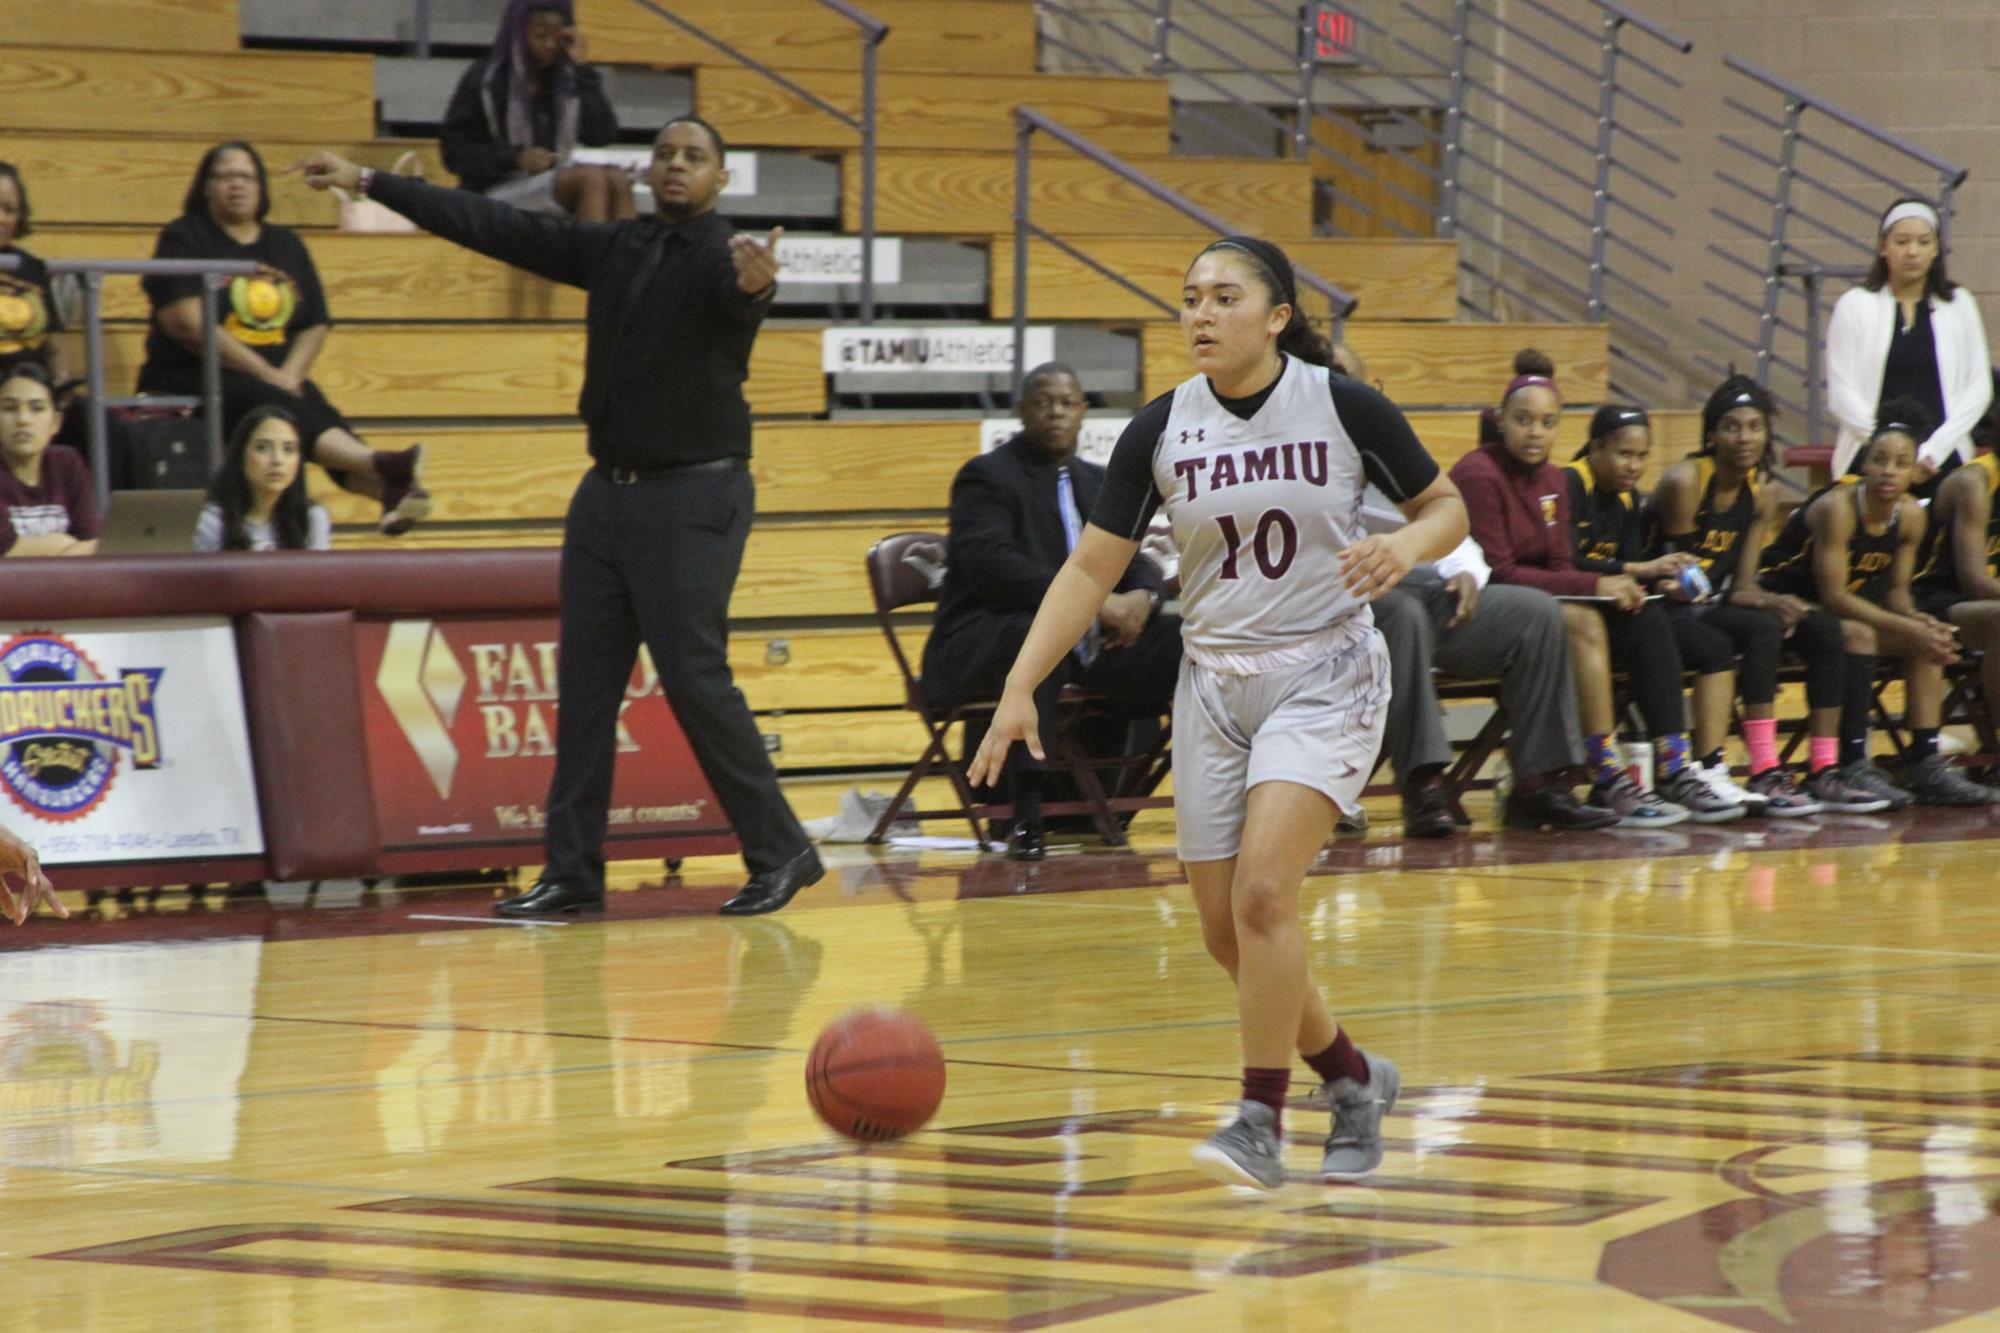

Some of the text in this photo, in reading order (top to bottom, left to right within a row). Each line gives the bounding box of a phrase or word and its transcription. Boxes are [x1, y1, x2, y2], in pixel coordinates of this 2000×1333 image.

[841, 337, 1016, 368] @TAMIUAthletic
[1173, 440, 1329, 503] TAMIU
[1214, 506, 1298, 581] 10
[479, 700, 641, 758] BAK
